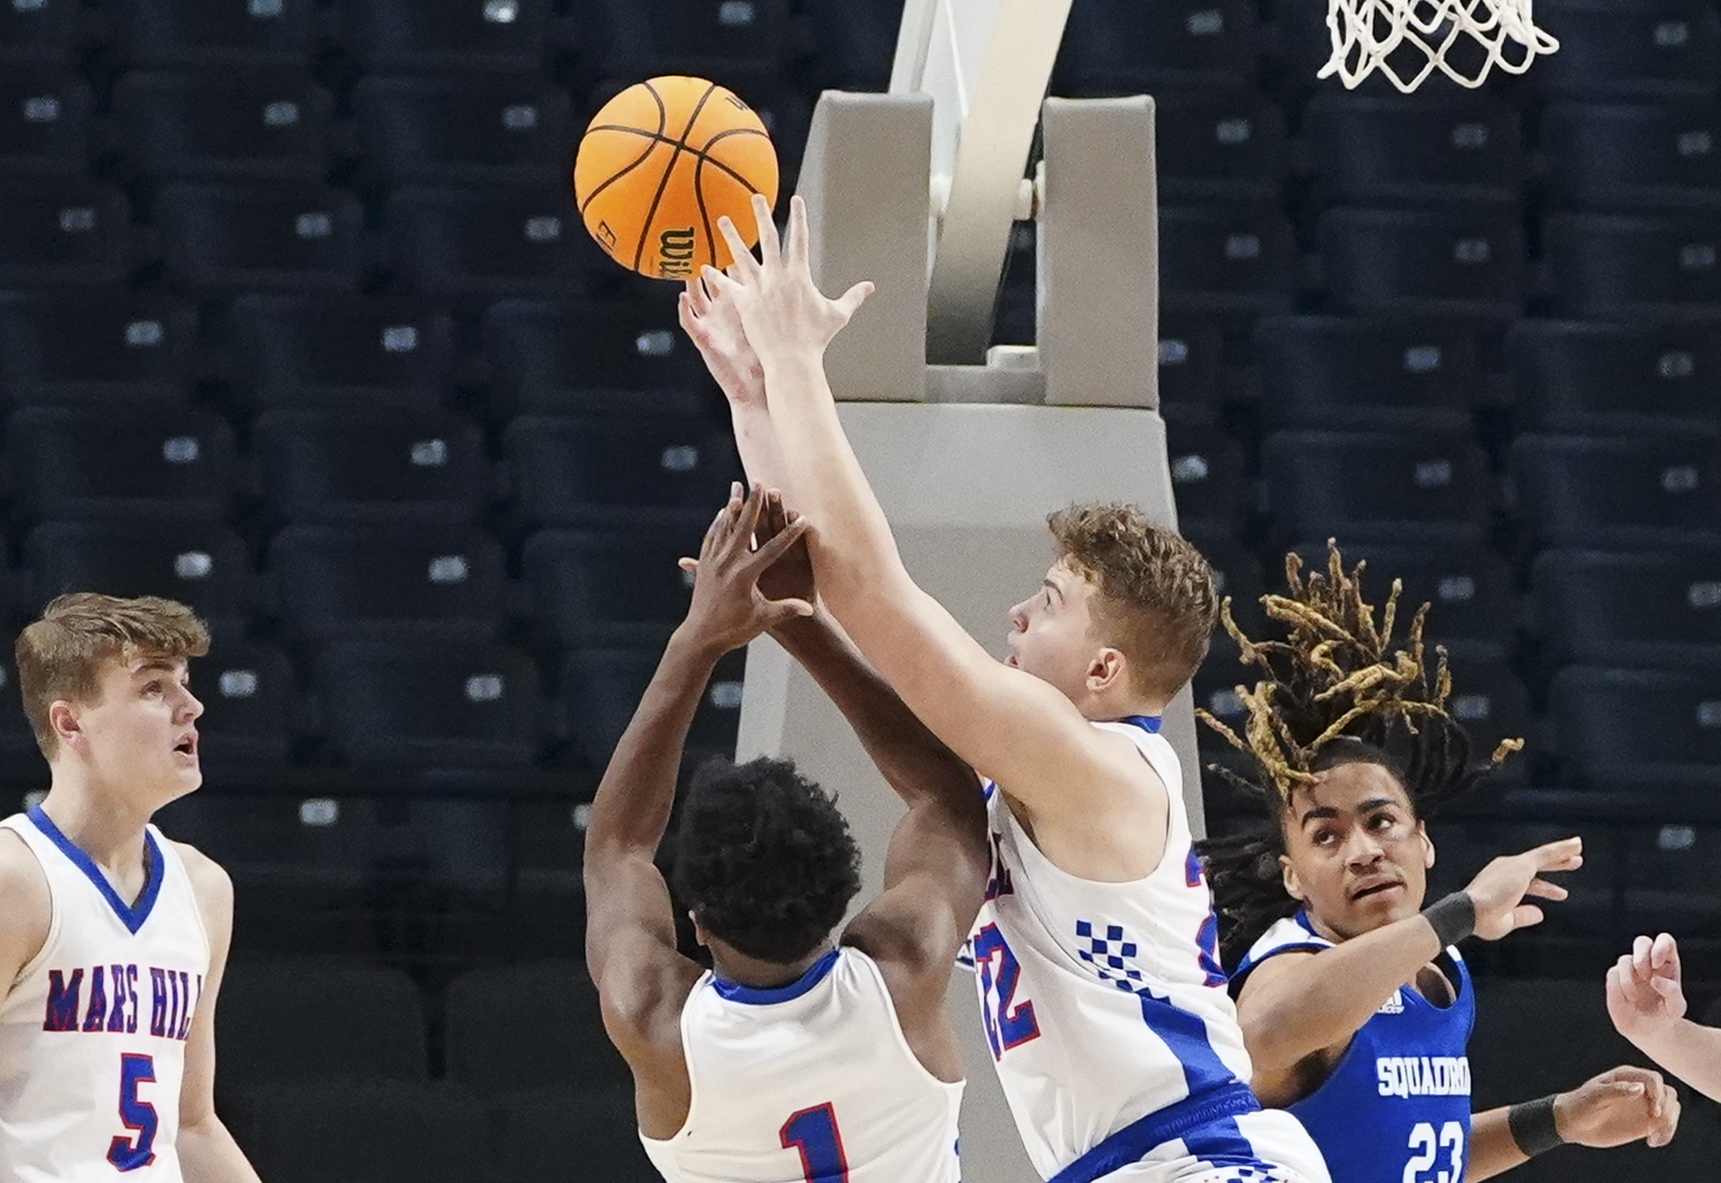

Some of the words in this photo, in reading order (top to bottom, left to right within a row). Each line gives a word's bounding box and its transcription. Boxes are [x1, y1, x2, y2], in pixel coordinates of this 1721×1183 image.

[42, 964, 138, 1034] MARS
[149, 966, 202, 1041] HIL
[106, 1052, 159, 1173] 5
[779, 1101, 849, 1183] 1
[1402, 1121, 1464, 1183] 23
